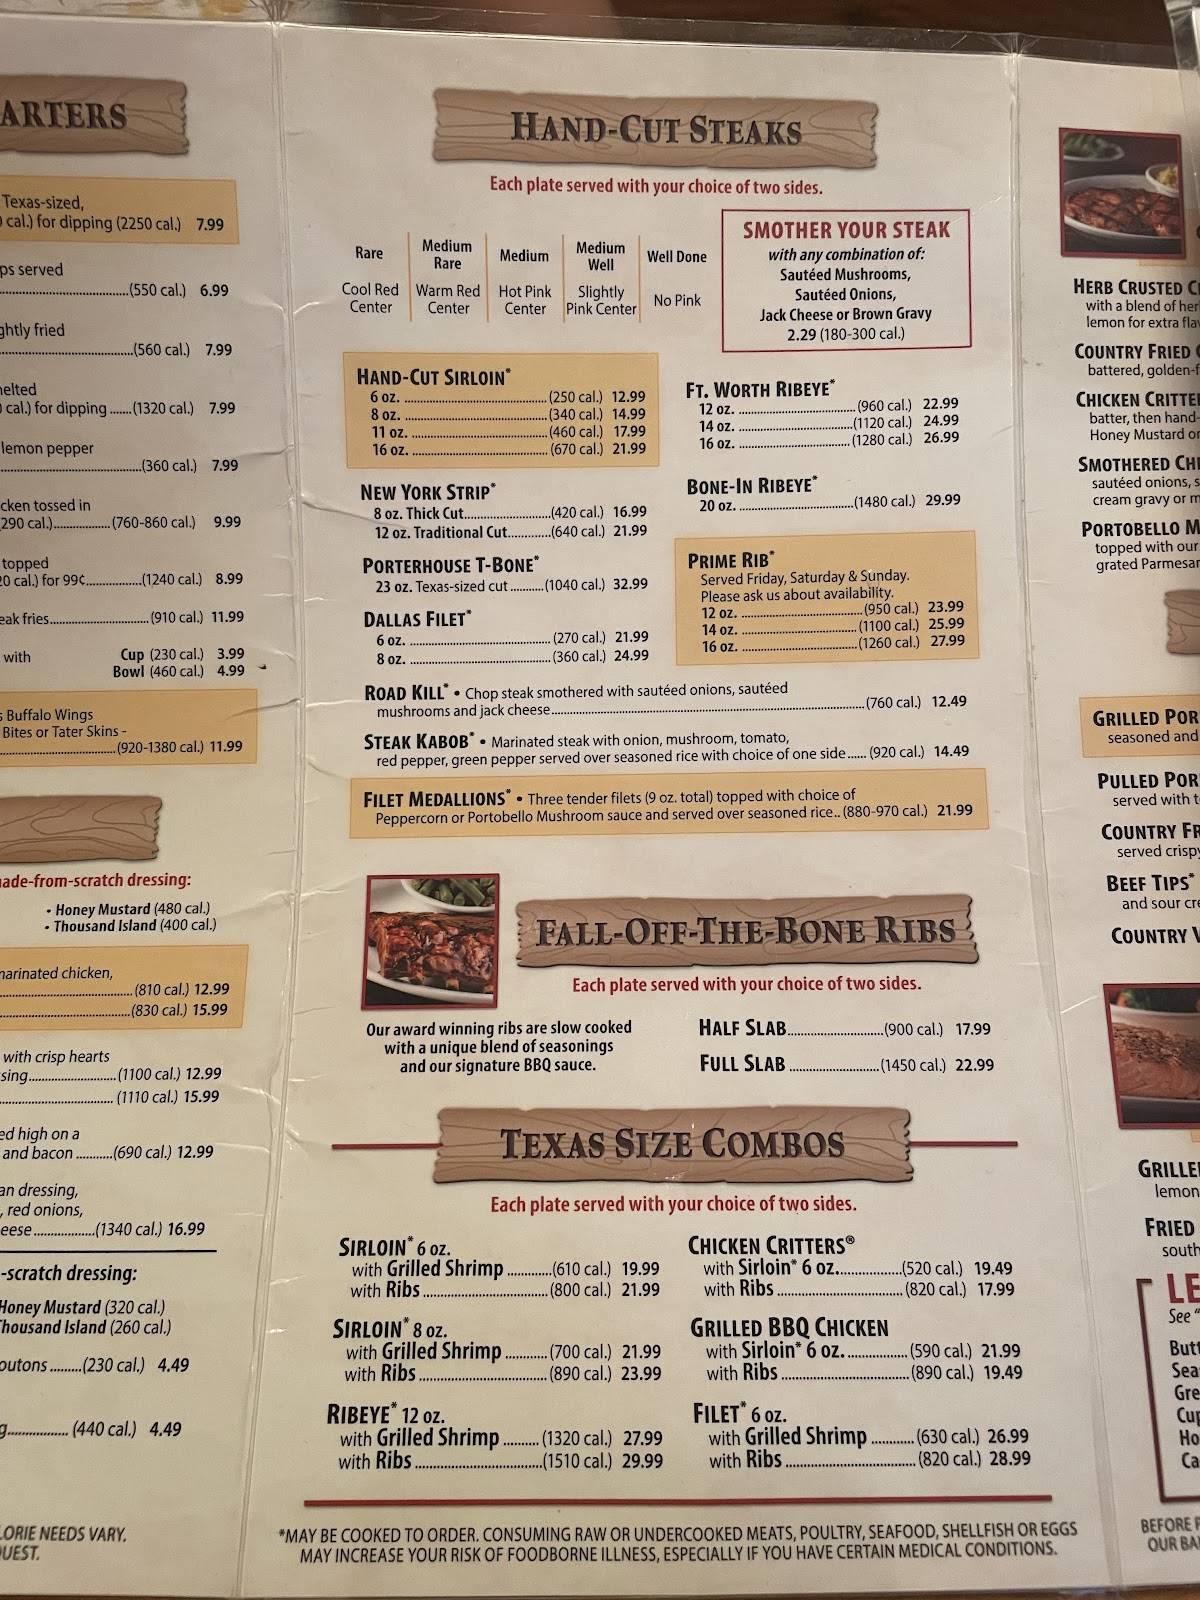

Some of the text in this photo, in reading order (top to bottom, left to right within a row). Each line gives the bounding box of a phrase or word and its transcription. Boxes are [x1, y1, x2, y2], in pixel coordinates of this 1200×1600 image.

[510, 111, 802, 146] HAND-CUT STEAKS
[491, 176, 823, 197] Each plate served with your choice of two sides.
[1, 194, 84, 212] Texas-sized,
[6, 213, 224, 233] cal.) for dipping (2250 cal.) 7.99
[744, 221, 950, 239] SMOTHER YOUR STEAK
[356, 246, 383, 259] Rare
[500, 249, 549, 262] Medium
[647, 250, 707, 263] Well Done
[769, 246, 925, 264] with any combination of:
[780, 267, 911, 282] Sautéed Mushrooms,
[129, 282, 229, 299] (550 cal.) 6.99
[342, 282, 399, 296] Cool Red
[416, 284, 480, 297] Warm Red
[1074, 278, 1182, 295] HERB CRUSTED
[654, 293, 701, 307] No Pink
[795, 288, 896, 302] Sautéed Onions,
[350, 300, 392, 313] Center
[1086, 299, 1176, 312] with a blend of
[760, 306, 932, 322] Jack Cheese or Brown Gravy
[788, 326, 905, 343] 2.29 (180-300 cal.)
[1075, 343, 1190, 359] COUNTRY FRIED
[357, 368, 439, 385] HAND-CUT
[1088, 363, 1144, 377] battered,
[370, 390, 646, 405] 6 oz. (250 cal.) 12.99
[1089, 412, 1161, 426] batter, then
[1090, 428, 1184, 444] Honey Mustard
[1, 441, 94, 458] lemon pepper
[361, 484, 396, 500] NEW
[401, 484, 442, 500] YORK
[613, 505, 647, 518] 16.99
[112, 515, 241, 531] (760-860 cal.) 9.99
[363, 557, 471, 574] PORTERHOUSE
[688, 553, 736, 569] PRIME
[701, 569, 909, 587] Served Friday, Saturday & Sunday.
[364, 611, 421, 627] DALLAS
[615, 631, 649, 643] 21.99
[121, 648, 245, 664] Cup (230 cal.) 3.99
[113, 664, 245, 679] Bowl (460 cal.) 4.99
[7, 708, 93, 724] Buffalo Wings
[3, 725, 118, 738] Bites or Tater Skins
[1098, 773, 1159, 789] PULLED
[56, 901, 210, 919] Honey Mustard (480 cal.)
[535, 916, 956, 947] FALL-OFF-THE-BONE RIBS
[367, 1020, 632, 1038] Our award winning ribs are slow cooked
[699, 1019, 991, 1036] HALF SLAB 17.99
[500, 1127, 845, 1159] TEXAS SIZE COMBOS
[1145, 1217, 1195, 1237] FRIED
[688, 1235, 760, 1255] CHICKEN
[691, 1316, 888, 1340] GRILLED BBQ CHICKEN
[83, 1356, 189, 1374] (230 cal.) 4.49
[300, 1541, 1057, 1563] MAY INCREASE YOUR RISK OF FOODBORNE ILLNESS, ESPECIALLY IF YOU HAVE CERTAIN MEDICAL CONDITIONS.
